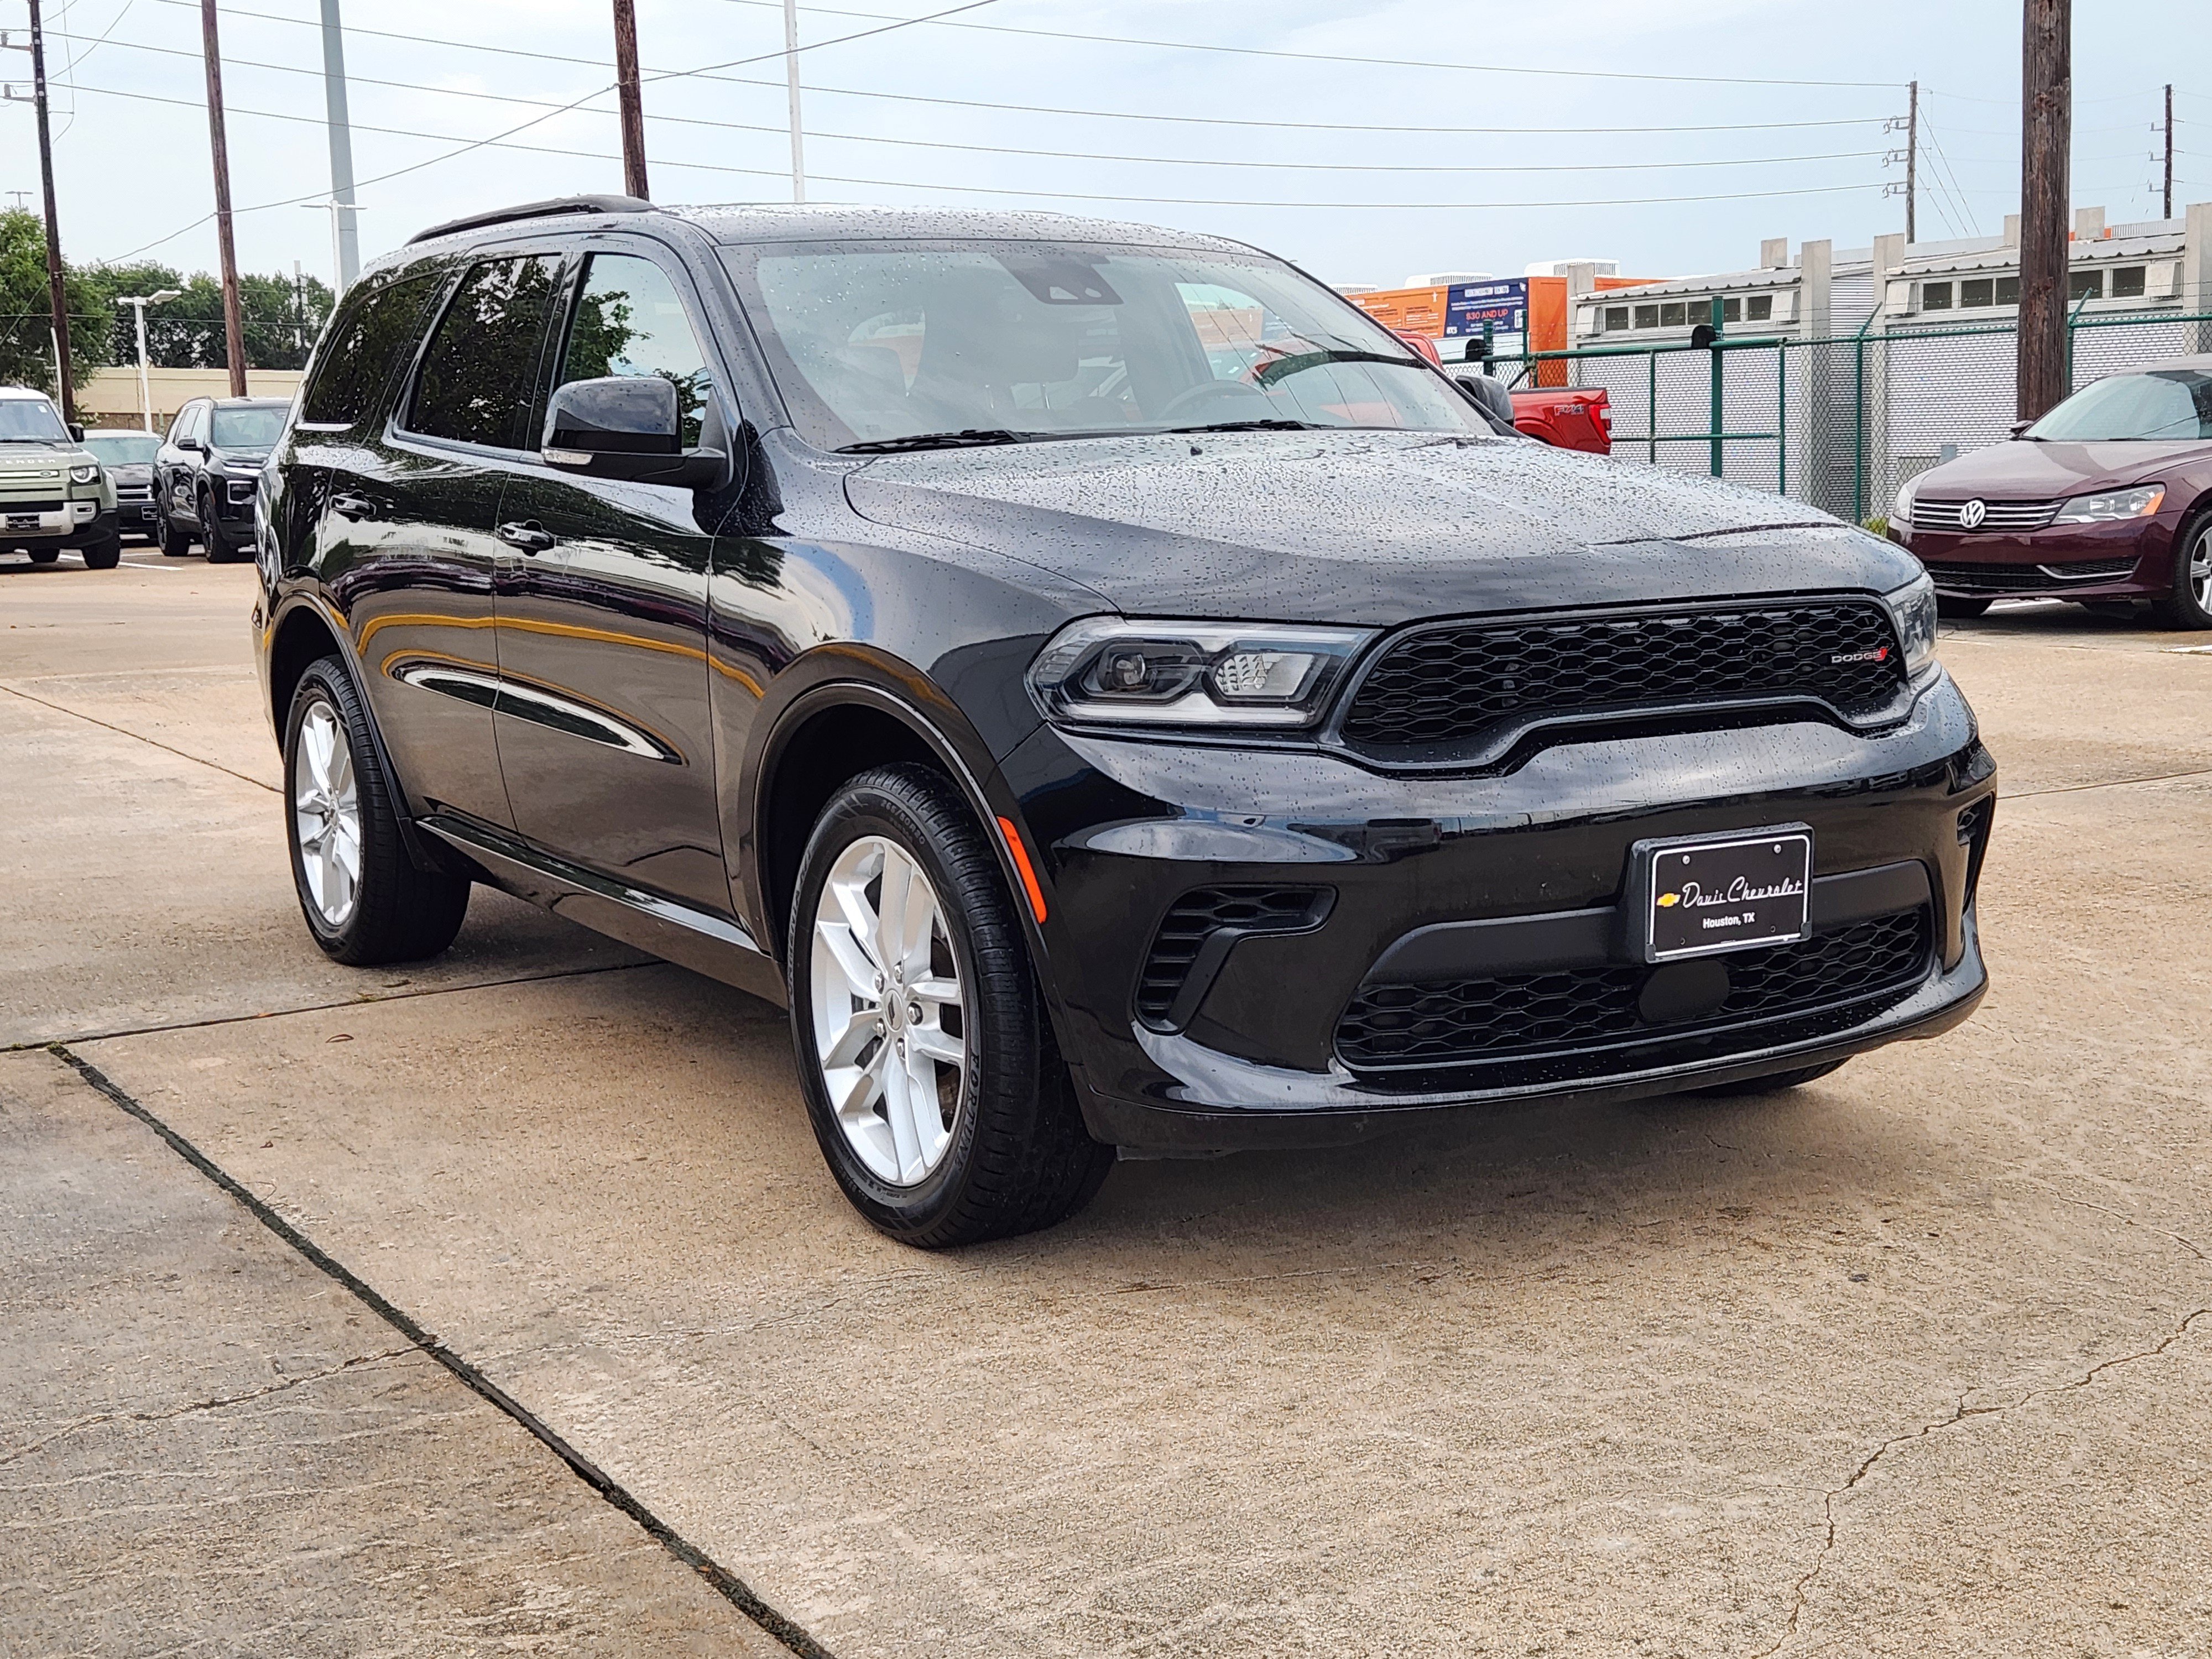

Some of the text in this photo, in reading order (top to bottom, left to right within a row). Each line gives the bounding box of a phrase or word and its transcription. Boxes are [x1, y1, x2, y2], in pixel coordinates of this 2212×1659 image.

[1481, 310, 1496, 319] AND
[1498, 308, 1509, 317] UP
[1832, 650, 1882, 663] DODGE
[1682, 876, 1803, 907] Davis Chevrolet
[1703, 912, 1755, 928] Houston, TX
[954, 1053, 980, 1172] FORTUNE
